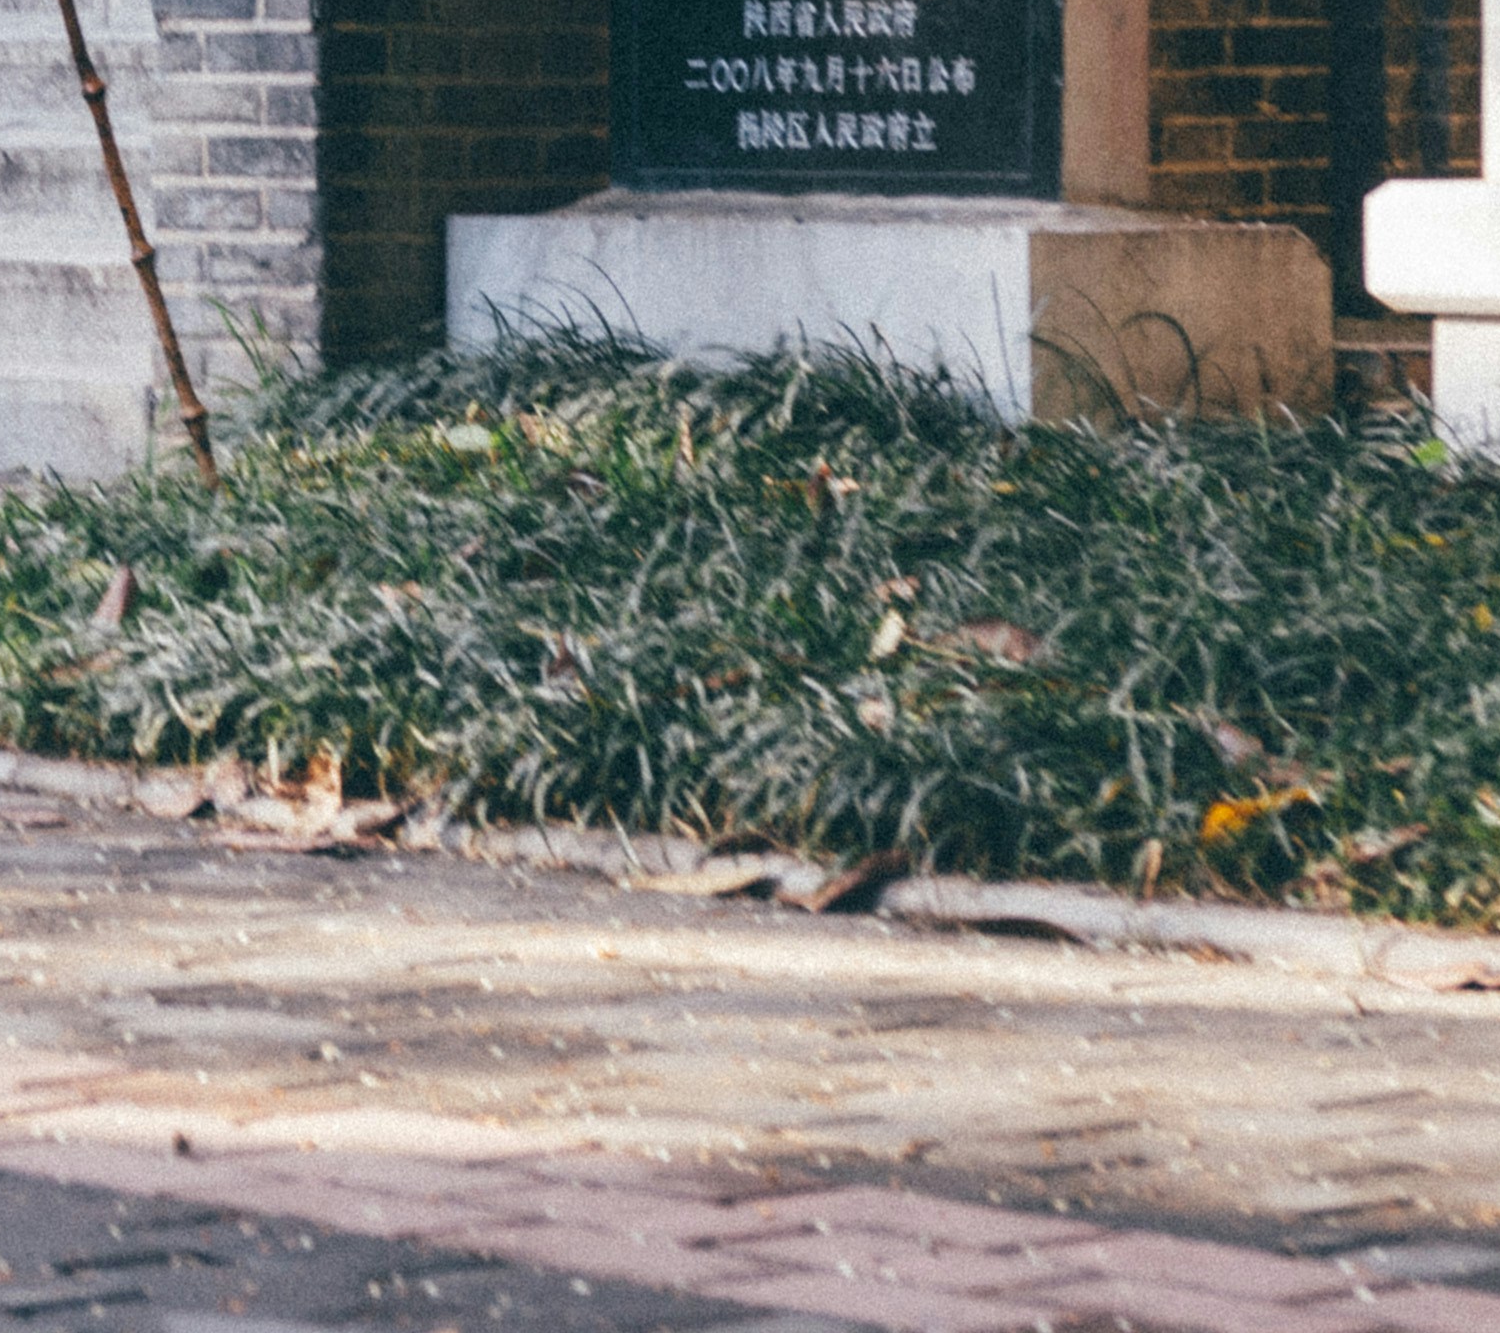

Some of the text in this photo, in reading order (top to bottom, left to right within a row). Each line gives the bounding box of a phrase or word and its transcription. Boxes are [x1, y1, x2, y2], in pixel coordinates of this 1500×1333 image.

[743, 0, 917, 39] 陕西省人民政府
